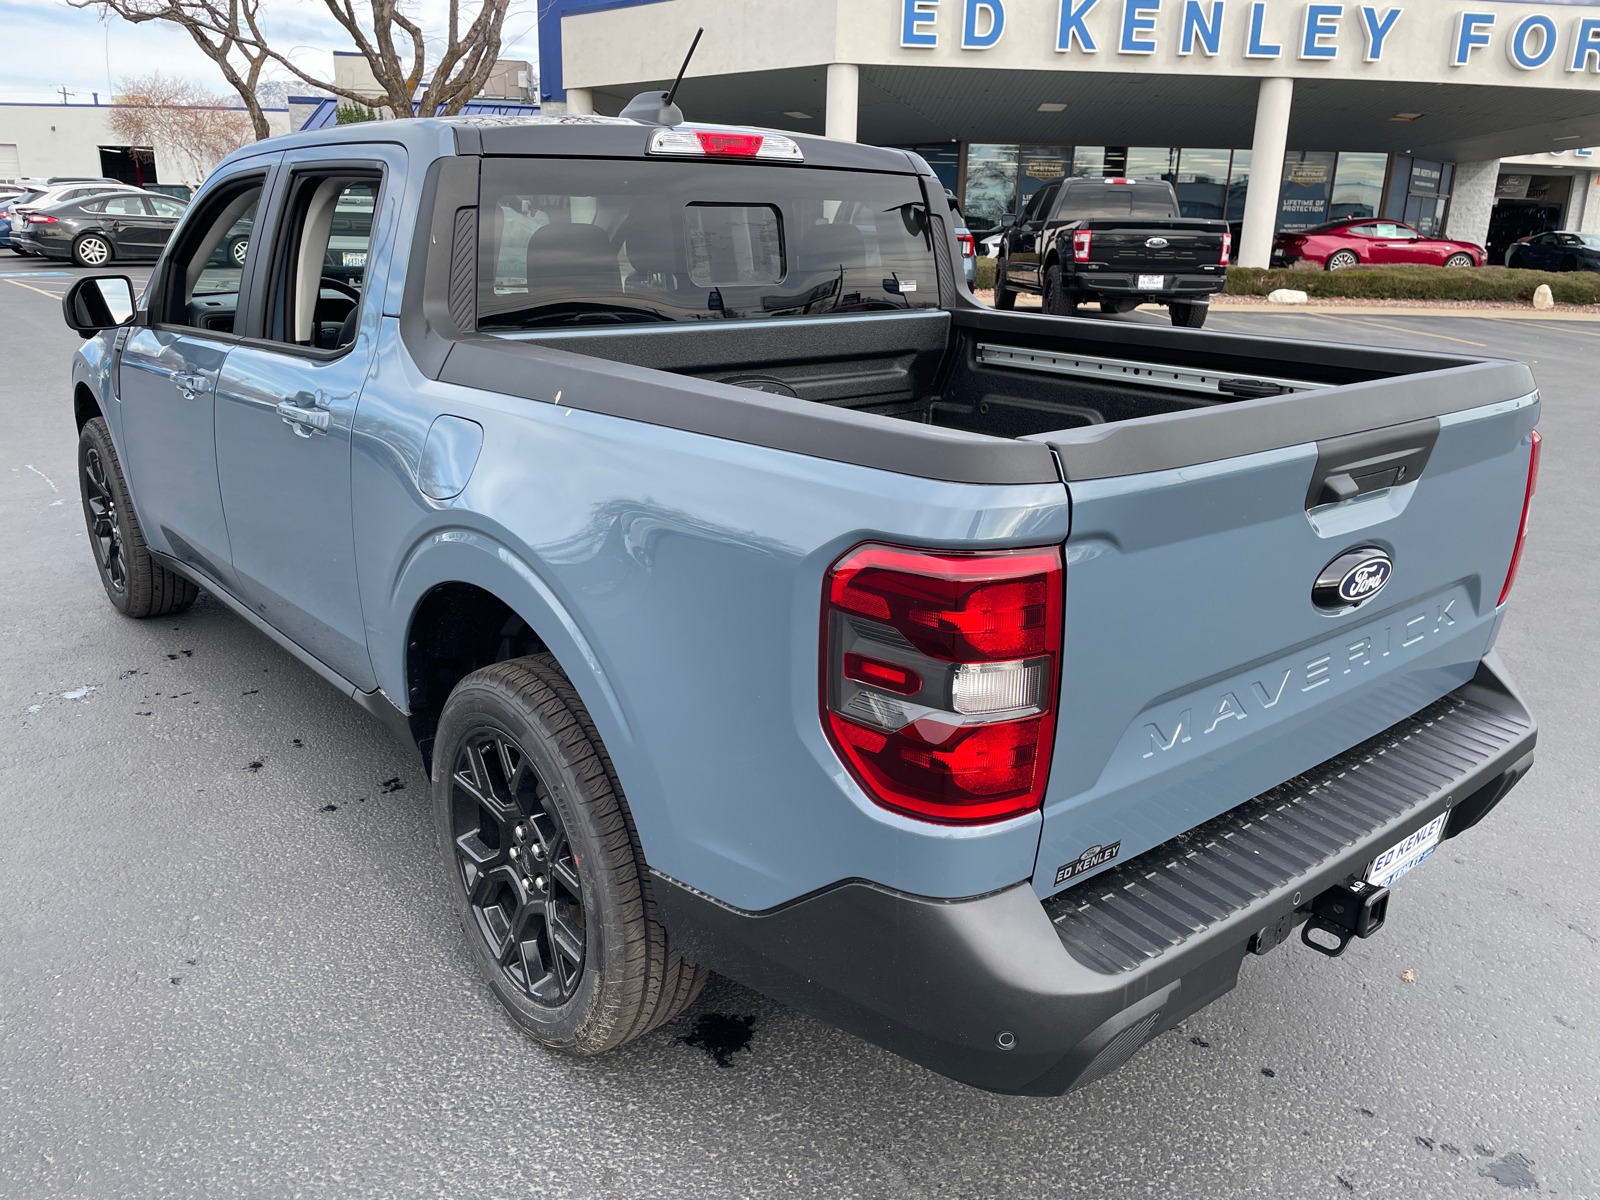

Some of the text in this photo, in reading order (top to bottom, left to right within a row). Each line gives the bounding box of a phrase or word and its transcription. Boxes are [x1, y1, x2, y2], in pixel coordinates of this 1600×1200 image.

[900, 0, 1006, 49] ED
[1055, 0, 1404, 62] KENLEY
[1349, 564, 1385, 597] Ford
[1143, 599, 1456, 759] MAVERICK
[1056, 845, 1120, 883] ED KENLEY
[1374, 849, 1396, 873] ED
[1396, 815, 1444, 860] KENLEY
